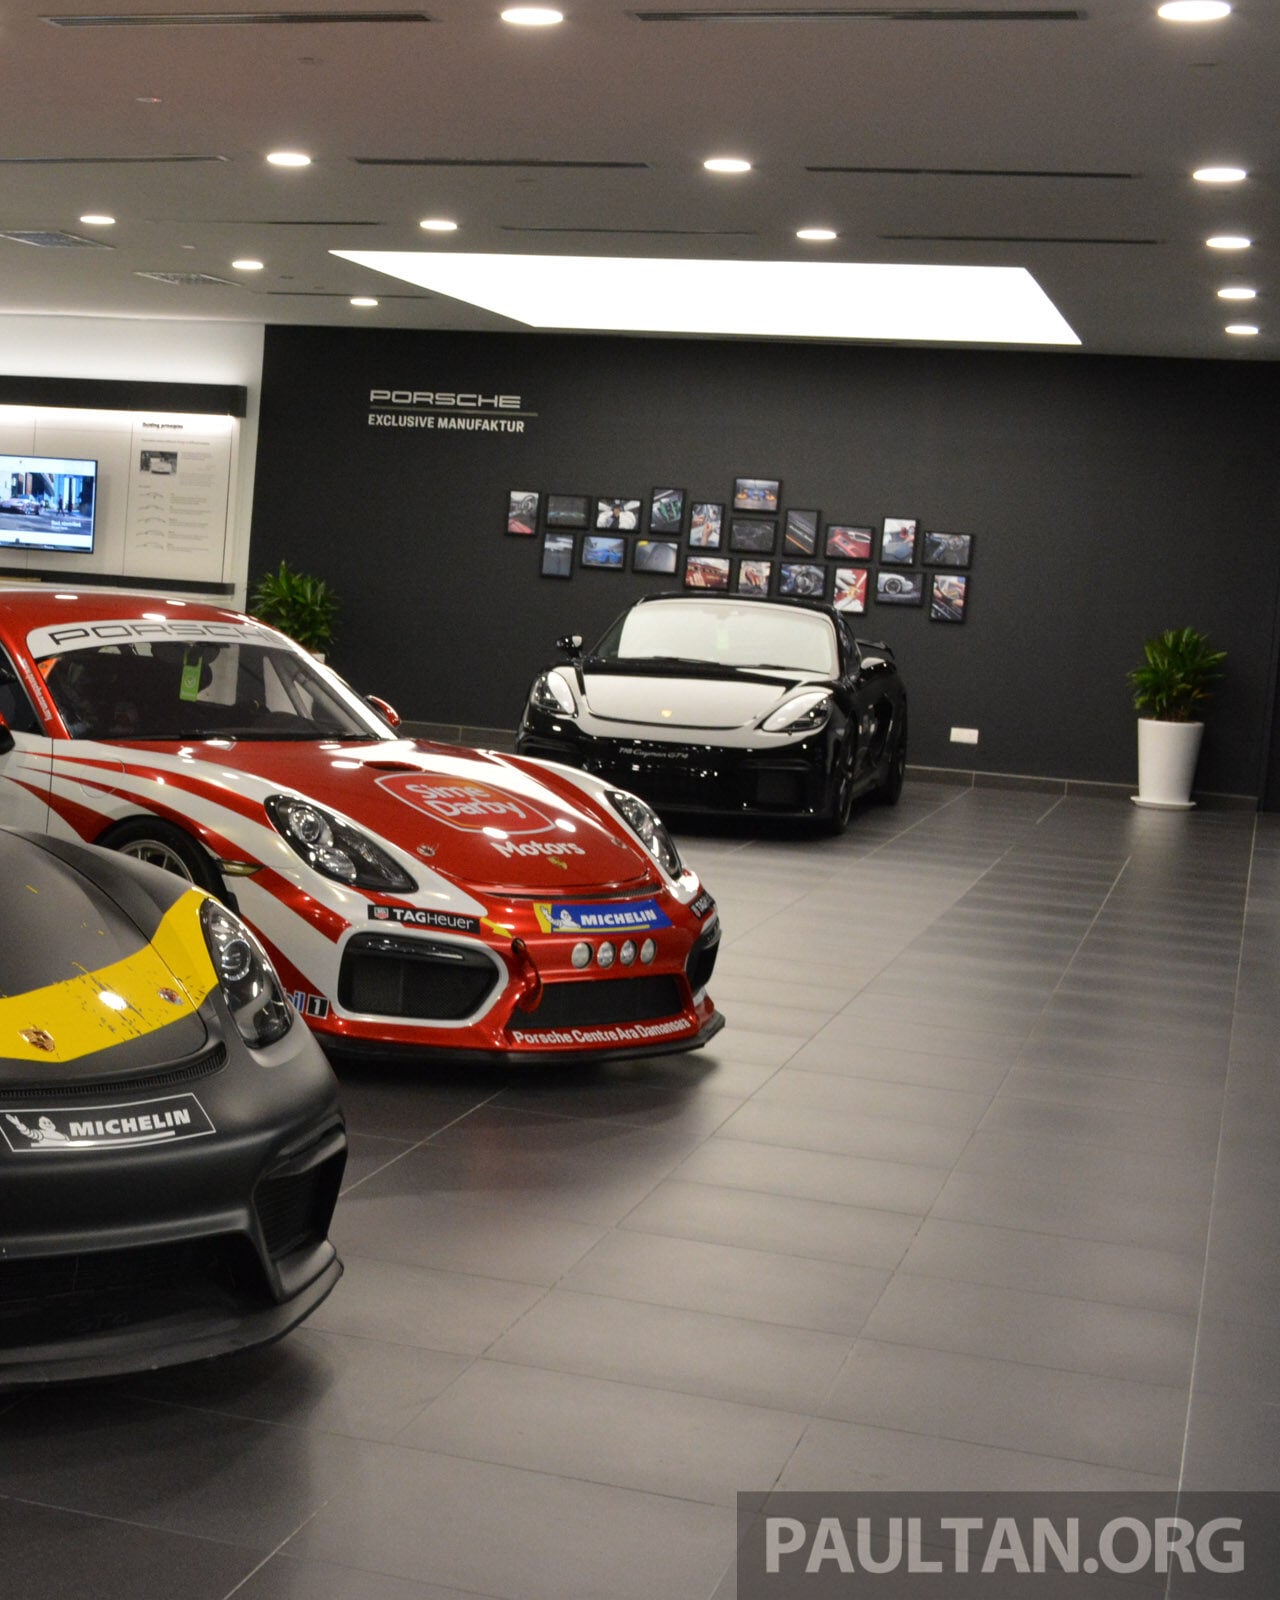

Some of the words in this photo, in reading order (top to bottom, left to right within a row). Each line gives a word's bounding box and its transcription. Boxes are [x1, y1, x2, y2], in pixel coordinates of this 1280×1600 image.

[370, 389, 521, 409] PORSCHE
[368, 414, 434, 428] EXCLUSIVE
[437, 417, 524, 432] MANUFAKTUR
[405, 783, 491, 800] Sime
[424, 797, 526, 819] Darby
[491, 840, 586, 858] Motors
[581, 909, 658, 925] MICHELIN
[512, 1030, 573, 1044] Porsche
[571, 1029, 619, 1043] Centre
[616, 1027, 639, 1040] Ara
[634, 1018, 691, 1038] Damansara
[69, 1109, 191, 1137] MICHELIN
